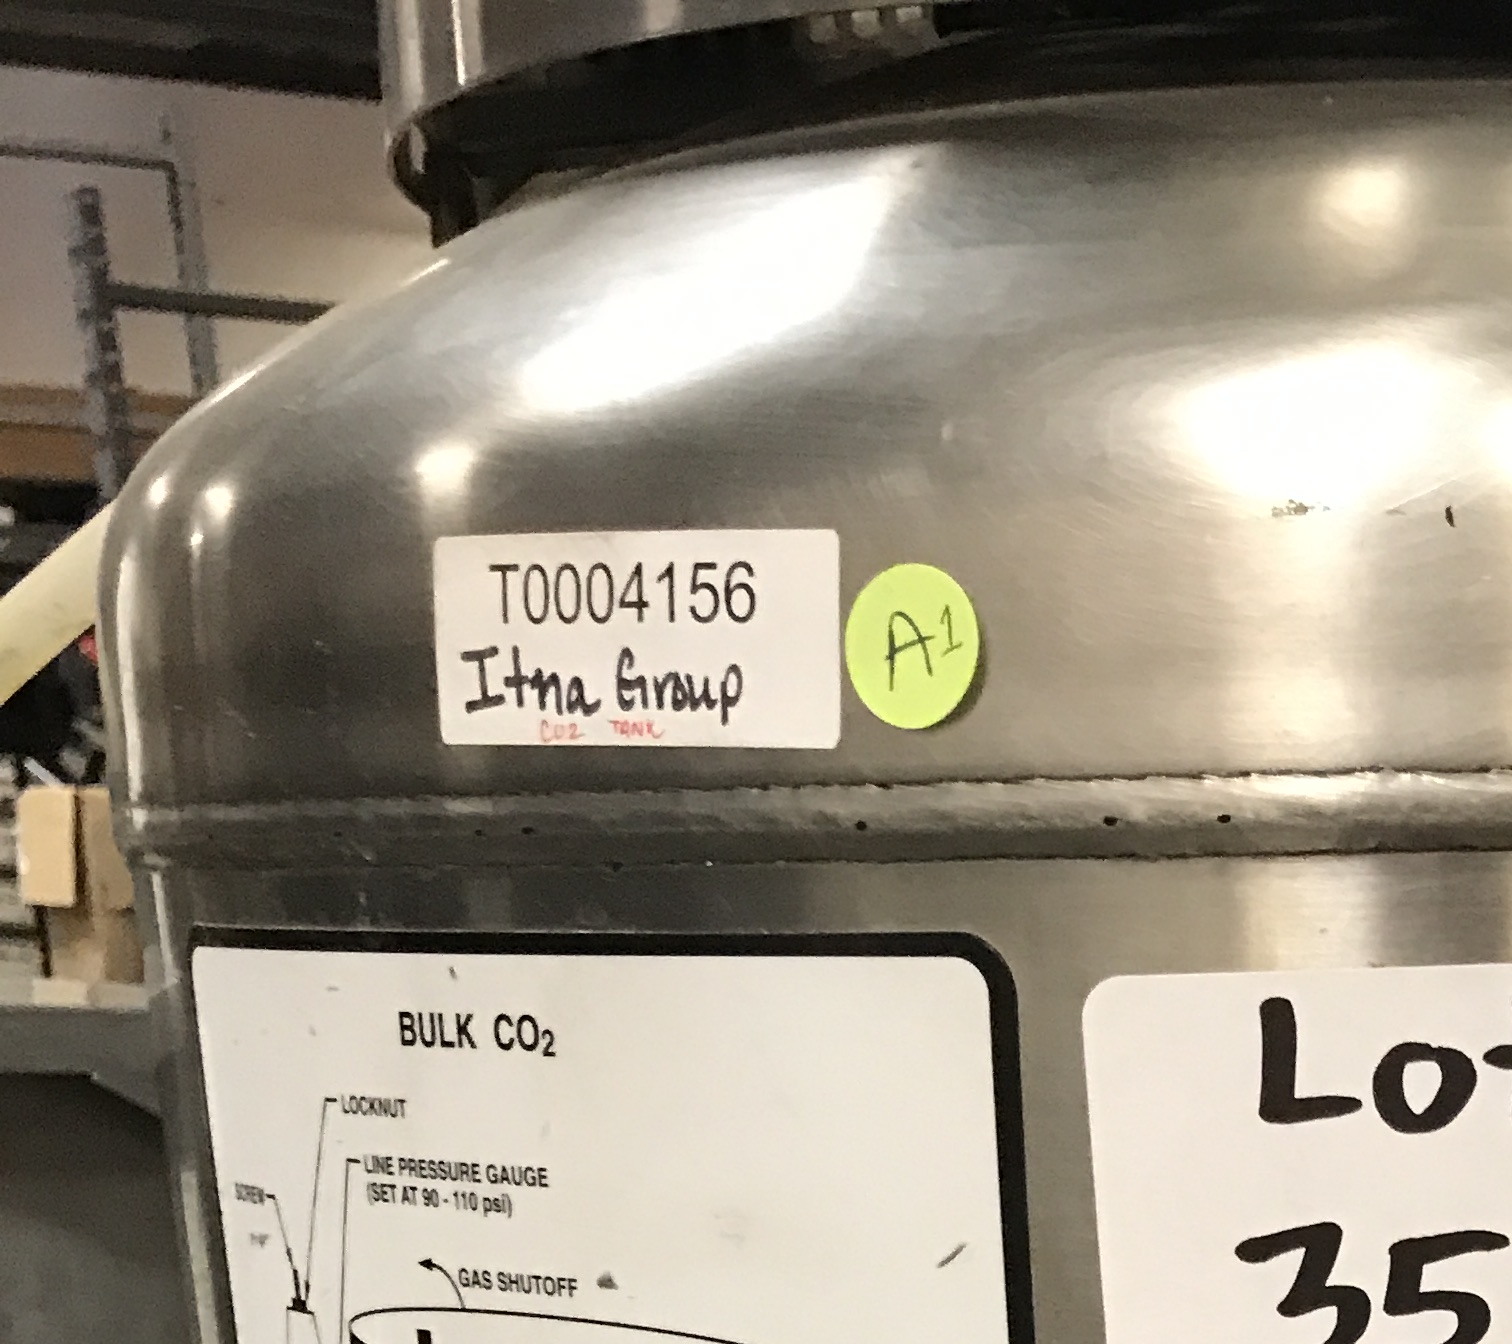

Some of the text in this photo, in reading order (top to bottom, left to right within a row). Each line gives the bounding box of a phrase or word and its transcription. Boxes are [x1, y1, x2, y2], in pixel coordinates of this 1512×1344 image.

[489, 560, 757, 625] T0004156
[614, 647, 744, 725] Group
[398, 1010, 477, 1050] BULK
[340, 1094, 407, 1119] LOCKNUT
[363, 1154, 549, 1188] LINE PRESSURE GAUGE
[457, 1267, 578, 1298] GAS SHUTOFF
